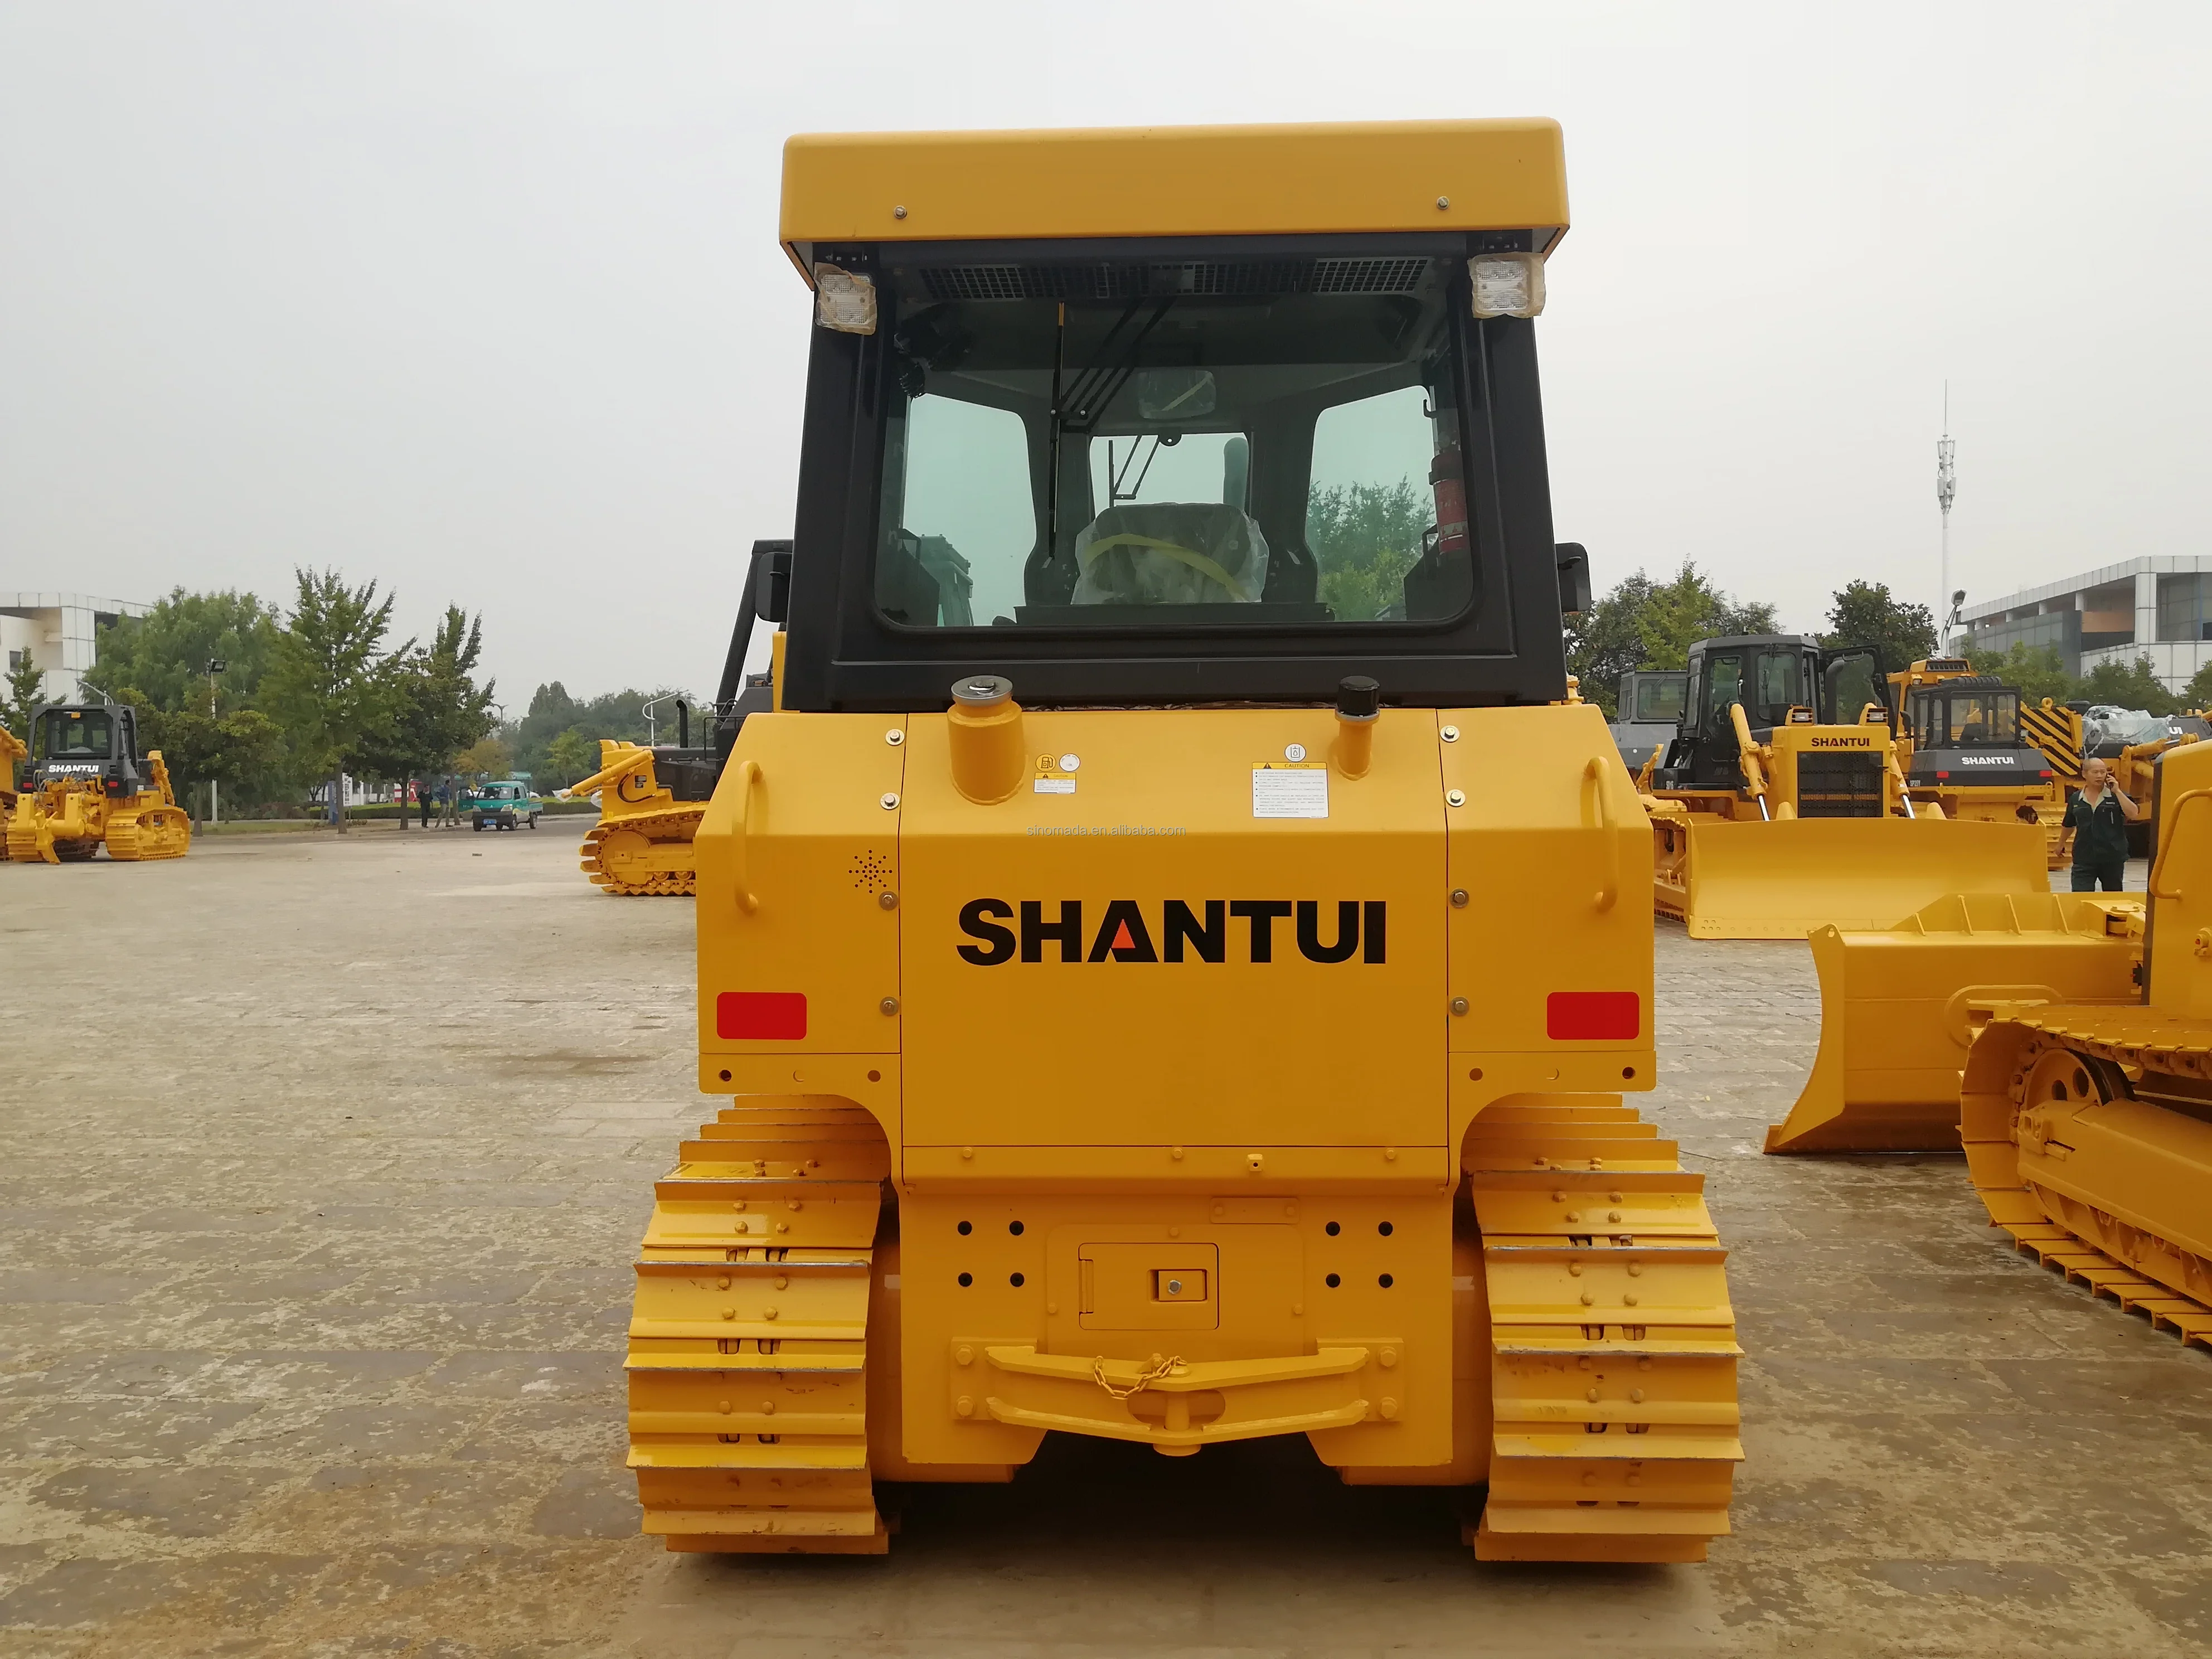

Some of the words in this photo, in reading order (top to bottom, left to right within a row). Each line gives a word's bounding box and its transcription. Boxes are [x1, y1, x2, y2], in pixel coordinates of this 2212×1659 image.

[1811, 738, 1870, 746] SHANTUI
[1961, 756, 2015, 765] SHANTUI
[956, 898, 1386, 966] SHANTUI
